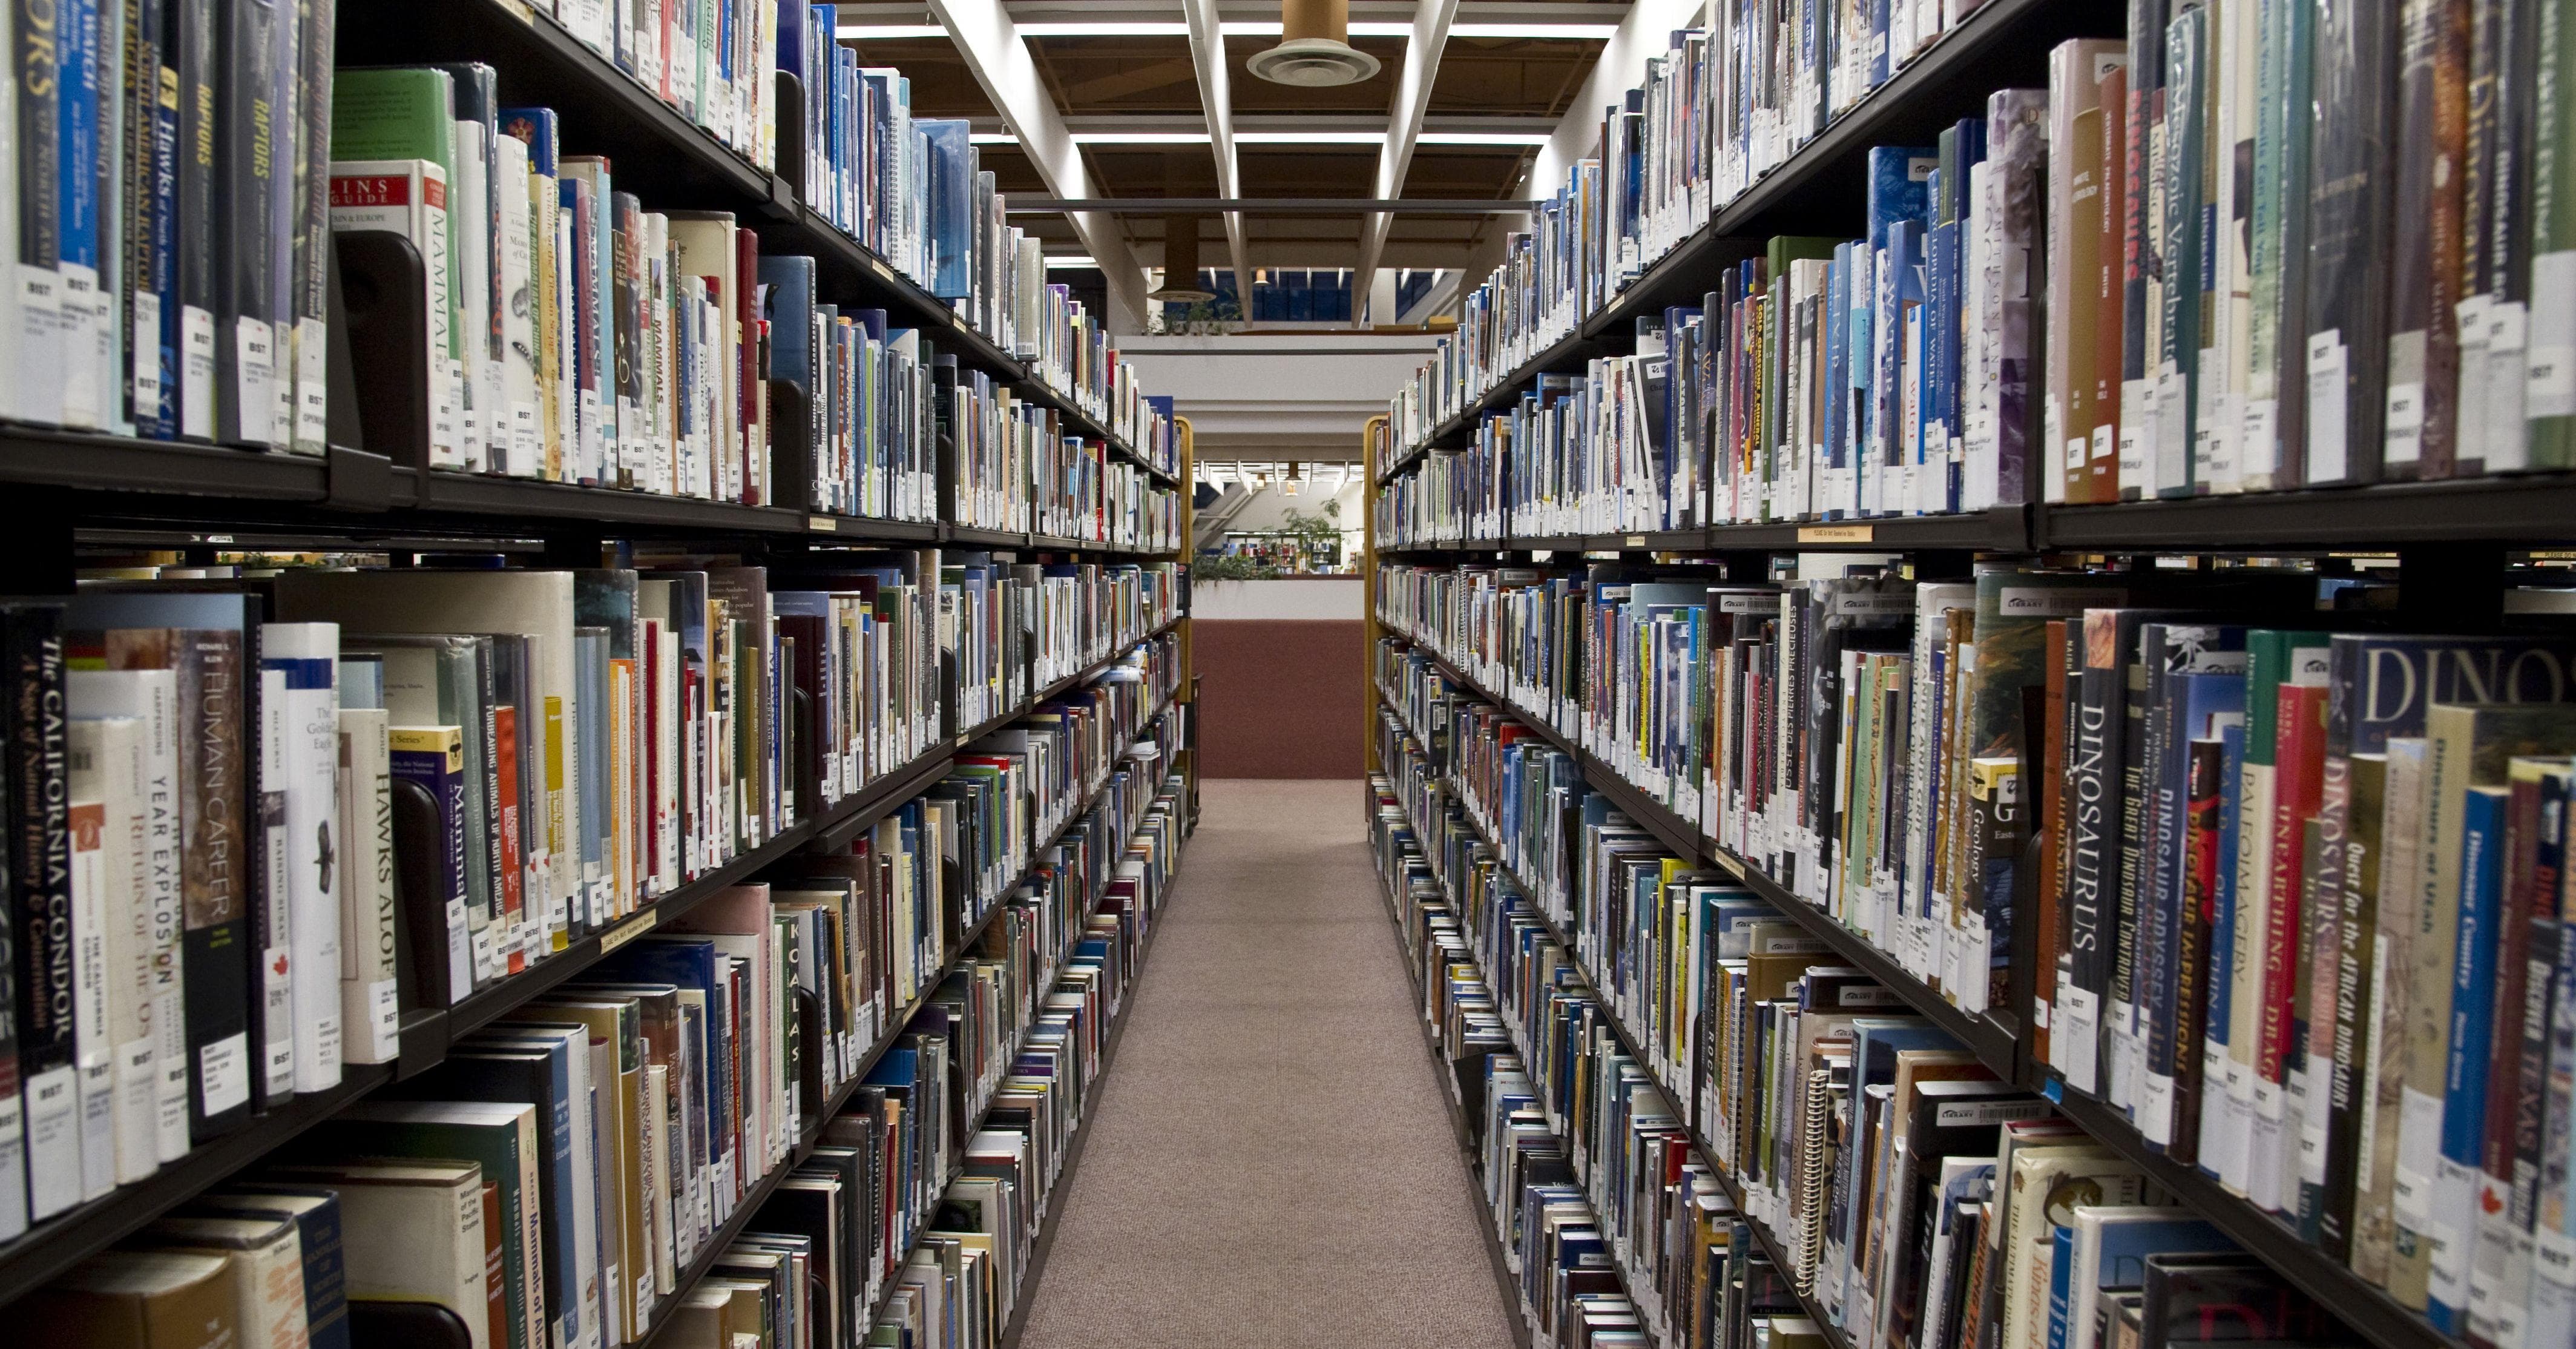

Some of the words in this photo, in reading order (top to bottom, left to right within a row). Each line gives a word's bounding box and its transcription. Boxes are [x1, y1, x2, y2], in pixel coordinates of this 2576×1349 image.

[197, 82, 212, 167] RAPTORS
[254, 97, 269, 179] RAPTORS
[159, 120, 175, 197] Hawks
[2124, 89, 2143, 283] DINOSAURS
[332, 193, 388, 203] GUIDE
[356, 214, 385, 222] EUROPE
[138, 216, 151, 292] RAPTOR
[1928, 188, 1938, 304] ENCYCLOPEDIA
[432, 213, 448, 349] MAMMAL
[1990, 206, 2002, 366] SMITHSONIAN
[249, 341, 266, 354] BST
[1884, 280, 1895, 394] WATER
[1928, 313, 1936, 331] OF
[654, 320, 665, 404] MAMMALS
[1927, 338, 1936, 389] WATER
[2312, 347, 2331, 361] BST
[309, 394, 323, 406] BST
[518, 411, 531, 420] BST
[2390, 398, 2412, 414] BST
[42, 637, 62, 681] The
[1943, 627, 1953, 713] ORIGINS
[1787, 676, 1796, 721] PIERRES
[203, 671, 224, 788] HUMAN
[396, 735, 421, 744] Series
[485, 705, 497, 768] FURBEARING
[1786, 723, 1795, 743] DES
[1940, 719, 1948, 743] OF
[43, 690, 70, 885] CALIFORNIA
[153, 776, 168, 836] YEAR
[488, 773, 499, 819] ANIMALS
[1937, 749, 1947, 822] ARABIA
[2127, 766, 2143, 790] THE
[2218, 755, 2232, 830] WARD
[2428, 737, 2447, 845] Dinosaurs
[376, 772, 394, 883] HAWKS
[453, 784, 468, 896] Mamma
[491, 823, 501, 834] OF
[1971, 809, 1985, 883] Geology
[2072, 704, 2105, 952] DINOSAURUS
[2124, 796, 2141, 842] GREAT
[2156, 788, 2174, 901] DINOSAUR
[2316, 757, 2347, 935] DINOSAURS
[206, 797, 231, 919] CAREER
[491, 838, 502, 872] NORTH
[2120, 847, 2139, 915] DINOSAUR
[2183, 813, 2201, 924] DINOSAUR
[2233, 771, 2257, 983] PALEOIMAGERY
[2346, 843, 2367, 884] Quest
[2425, 850, 2439, 876] of
[154, 849, 174, 984] EXPLOSION
[451, 908, 460, 917] BST
[555, 907, 565, 915] BST
[2213, 874, 2226, 925] OUT
[2266, 805, 2293, 972] UNEARTHING
[2345, 890, 2363, 915] for
[2422, 882, 2437, 934] Utah
[377, 893, 395, 975] ALOF
[2117, 920, 2135, 1002] CONTROVER
[2150, 909, 2167, 1009] ODYSSEY
[2342, 923, 2360, 951] the
[2457, 917, 2478, 990] Country
[48, 893, 73, 1041] CONDOR
[788, 923, 800, 1061] KOALAS
[2207, 951, 2223, 1010] THIN
[2338, 957, 2358, 1021] AFRICAN
[384, 1011, 397, 1023] BST
[2071, 998, 2085, 1009] BST
[2174, 930, 2195, 1072] IMPRESSIONS
[274, 1052, 291, 1066] BST
[668, 1053, 677, 1094] PACIFIC
[2331, 1024, 2353, 1110] DINOSAURS
[467, 1198, 477, 1208] the
[512, 1187, 521, 1233] Mammals
[1834, 1150, 1842, 1216] GEOLOGY
[461, 1208, 479, 1222] Pacific
[461, 1219, 479, 1233] States
[2012, 1204, 2020, 1227] THE
[529, 1211, 540, 1293] Mammals
[2006, 1235, 2019, 1292] ULTIMATE
[533, 1296, 544, 1314] of
[2029, 1257, 2048, 1317] Kings
[534, 1317, 545, 1349] Alas
